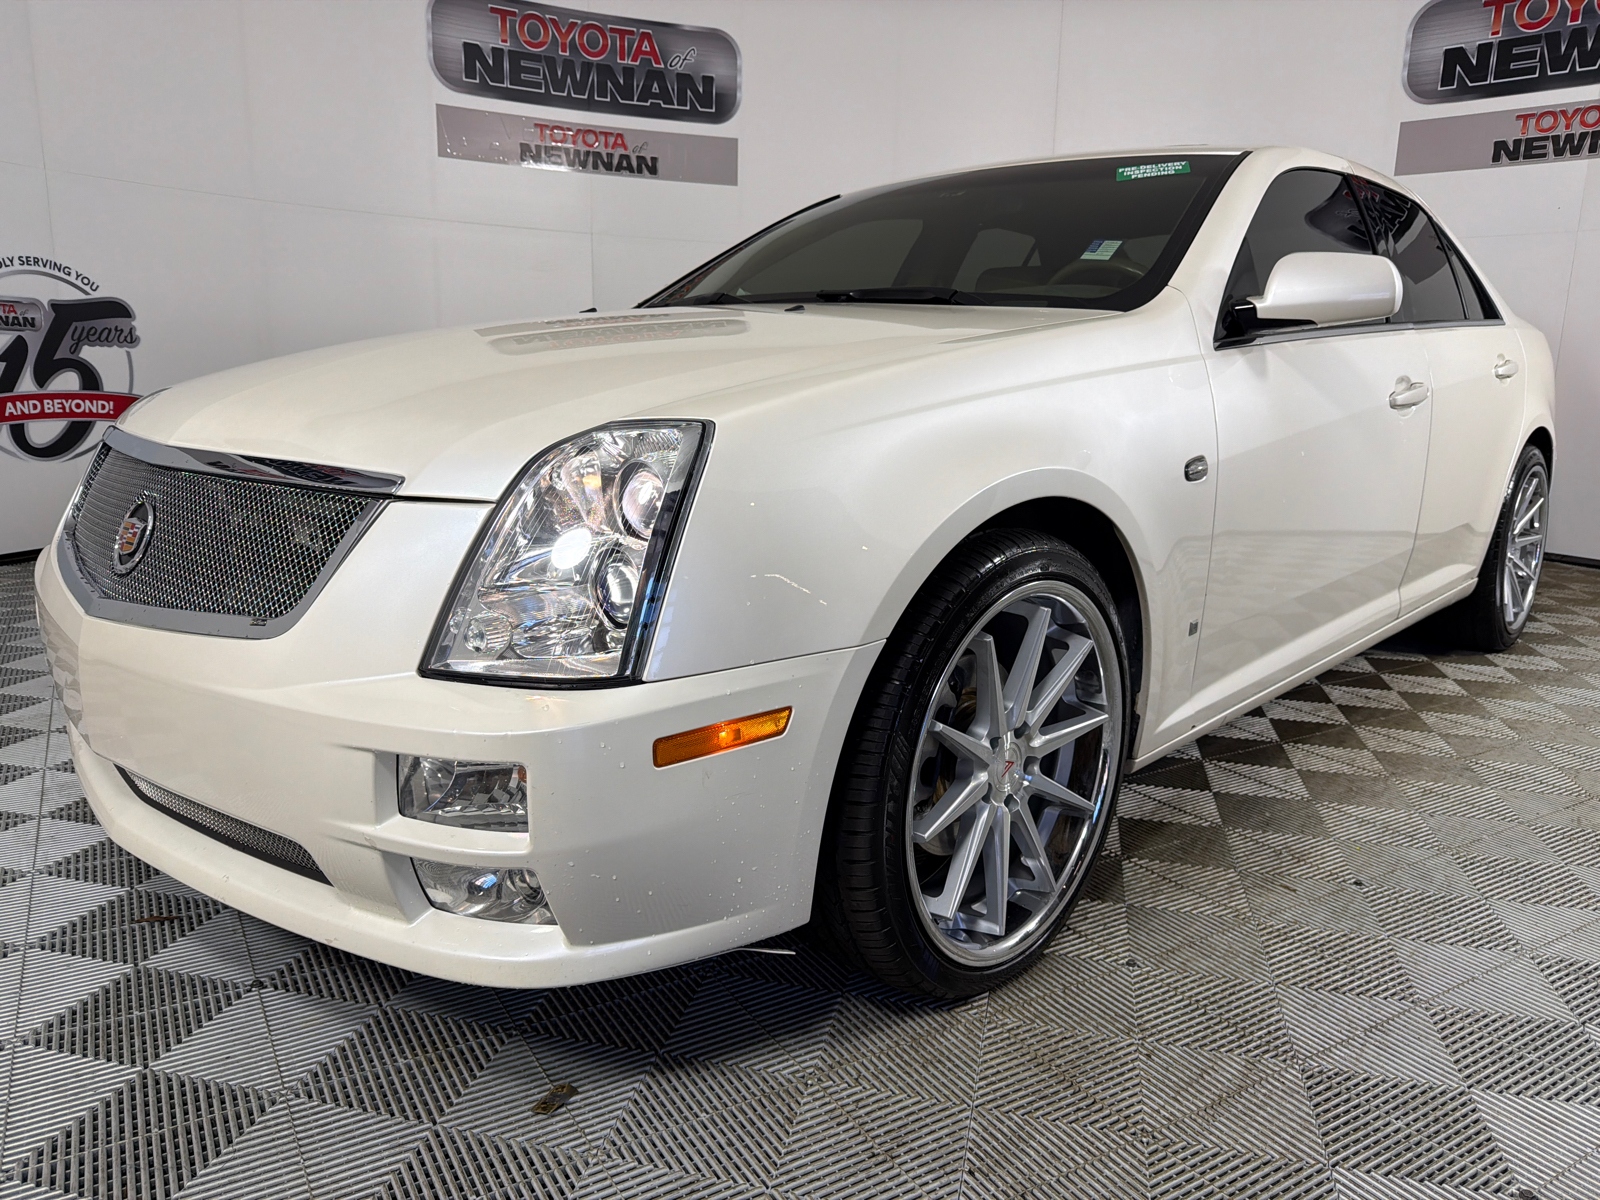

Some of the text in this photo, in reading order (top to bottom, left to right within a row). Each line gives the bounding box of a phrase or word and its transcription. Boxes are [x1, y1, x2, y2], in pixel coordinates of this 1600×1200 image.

[1483, 0, 1600, 37] TOY
[488, 4, 696, 70] TOYOTA of
[461, 40, 715, 112] NEWNAN
[534, 122, 628, 151] TOYOTA
[519, 142, 658, 177] NEWNAN
[1118, 161, 1187, 173] PRE-DELIVERY
[1123, 165, 1183, 176] INSPECTION
[1131, 170, 1176, 179] PENDING
[0, 256, 100, 292] LY SERVING YOU
[69, 326, 137, 354] years
[4, 400, 114, 417] AND BEYOND!
